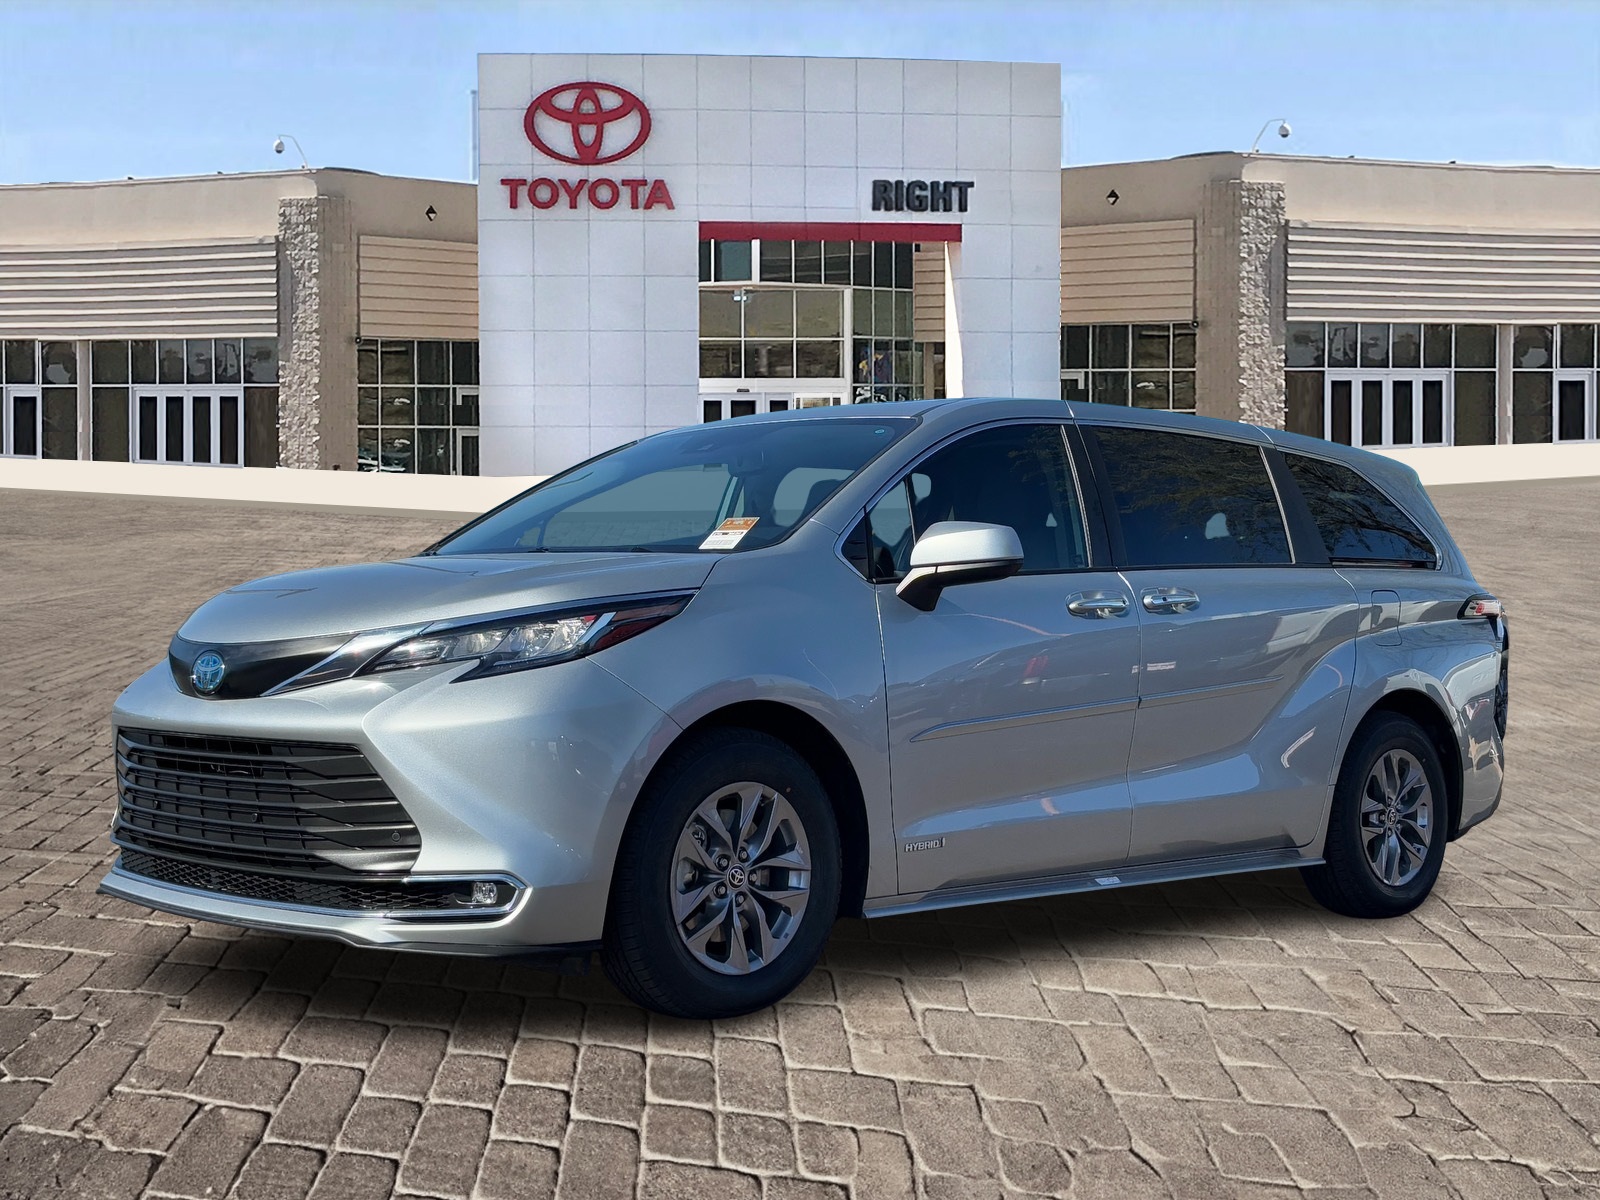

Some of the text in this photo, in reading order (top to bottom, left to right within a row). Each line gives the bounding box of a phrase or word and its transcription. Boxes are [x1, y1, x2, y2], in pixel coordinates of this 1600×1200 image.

[500, 177, 675, 210] TOYOTA
[872, 180, 974, 212] RIGHT
[904, 839, 941, 852] HYBRID
